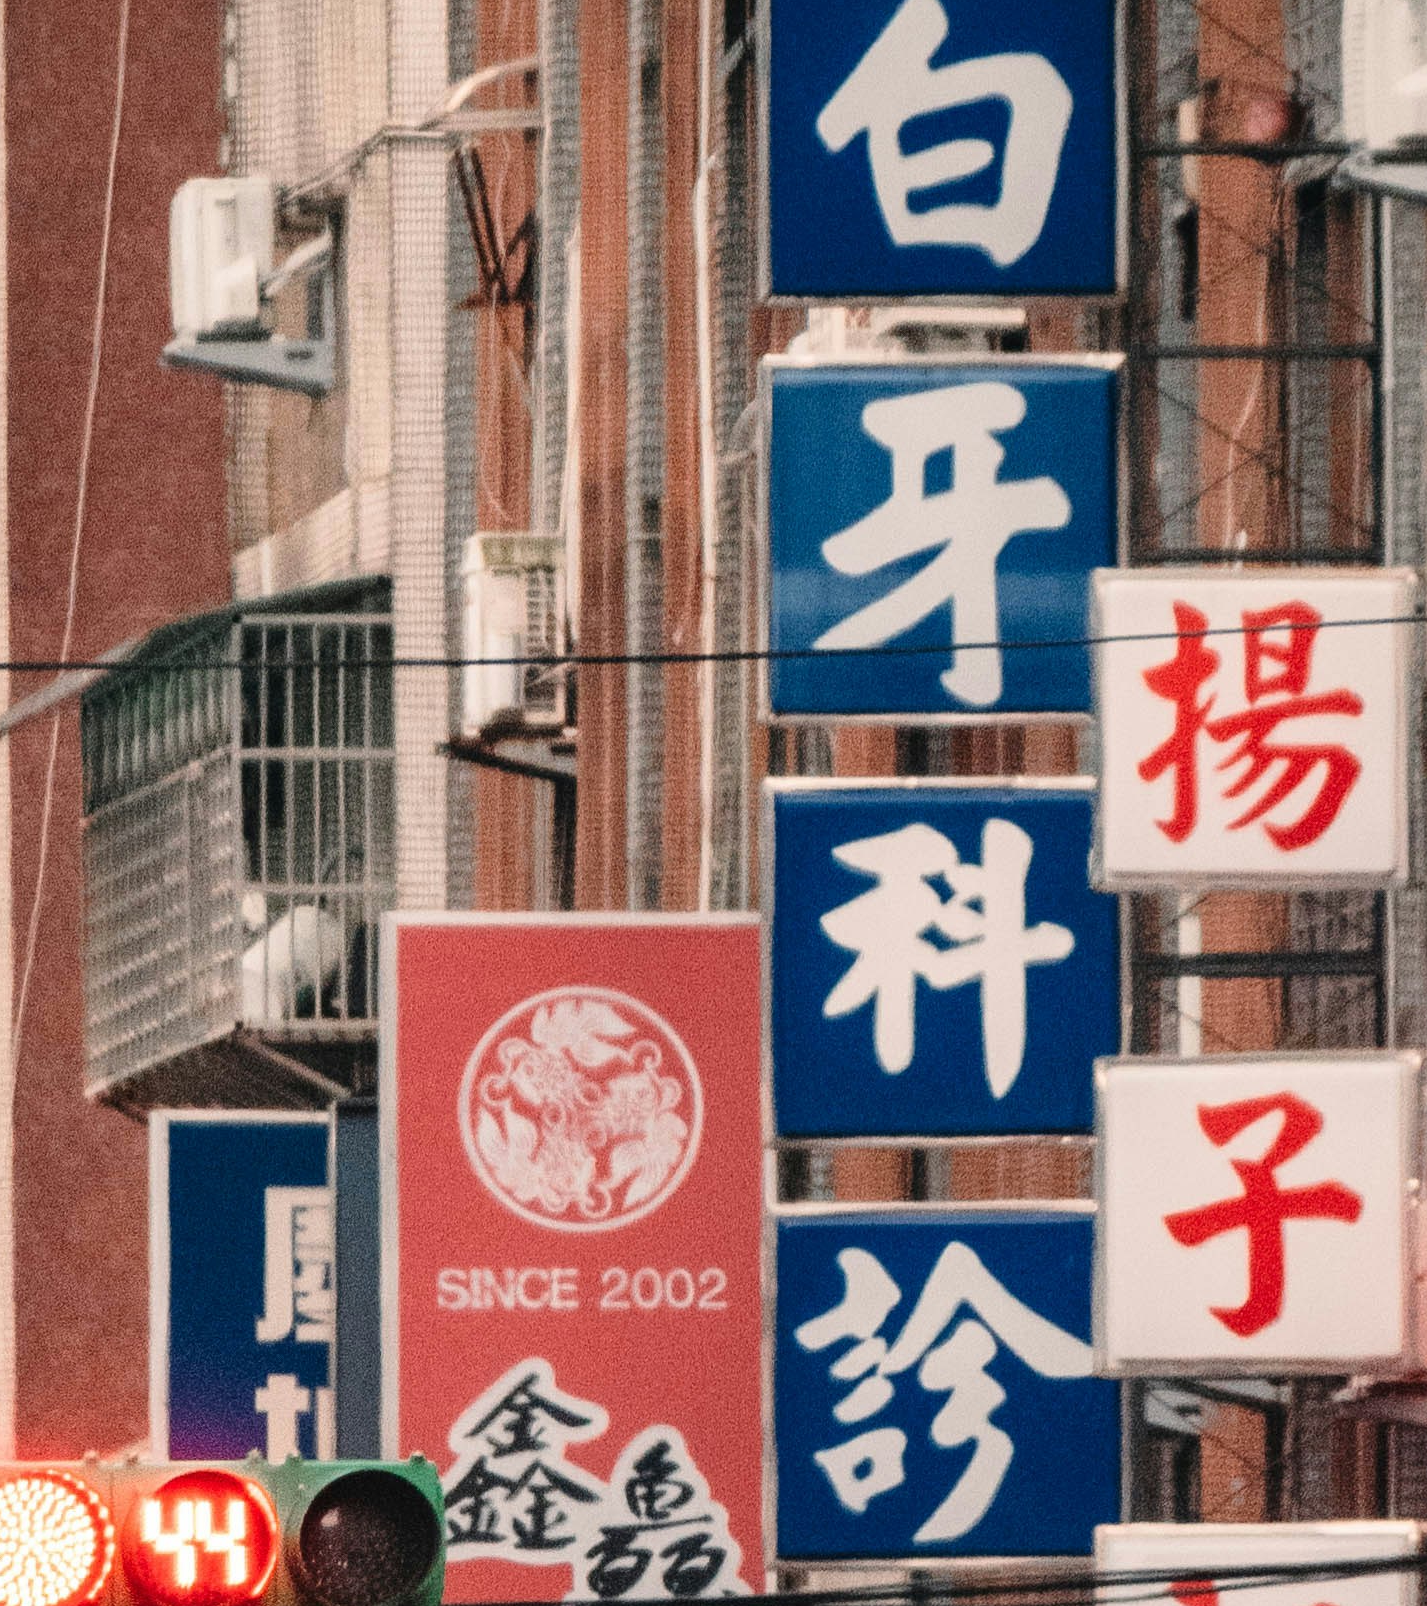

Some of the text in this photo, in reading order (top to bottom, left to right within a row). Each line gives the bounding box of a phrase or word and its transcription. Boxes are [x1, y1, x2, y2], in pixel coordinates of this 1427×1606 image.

[436, 1265, 728, 1310] SINCE 2002
[144, 1498, 248, 1586] 44
